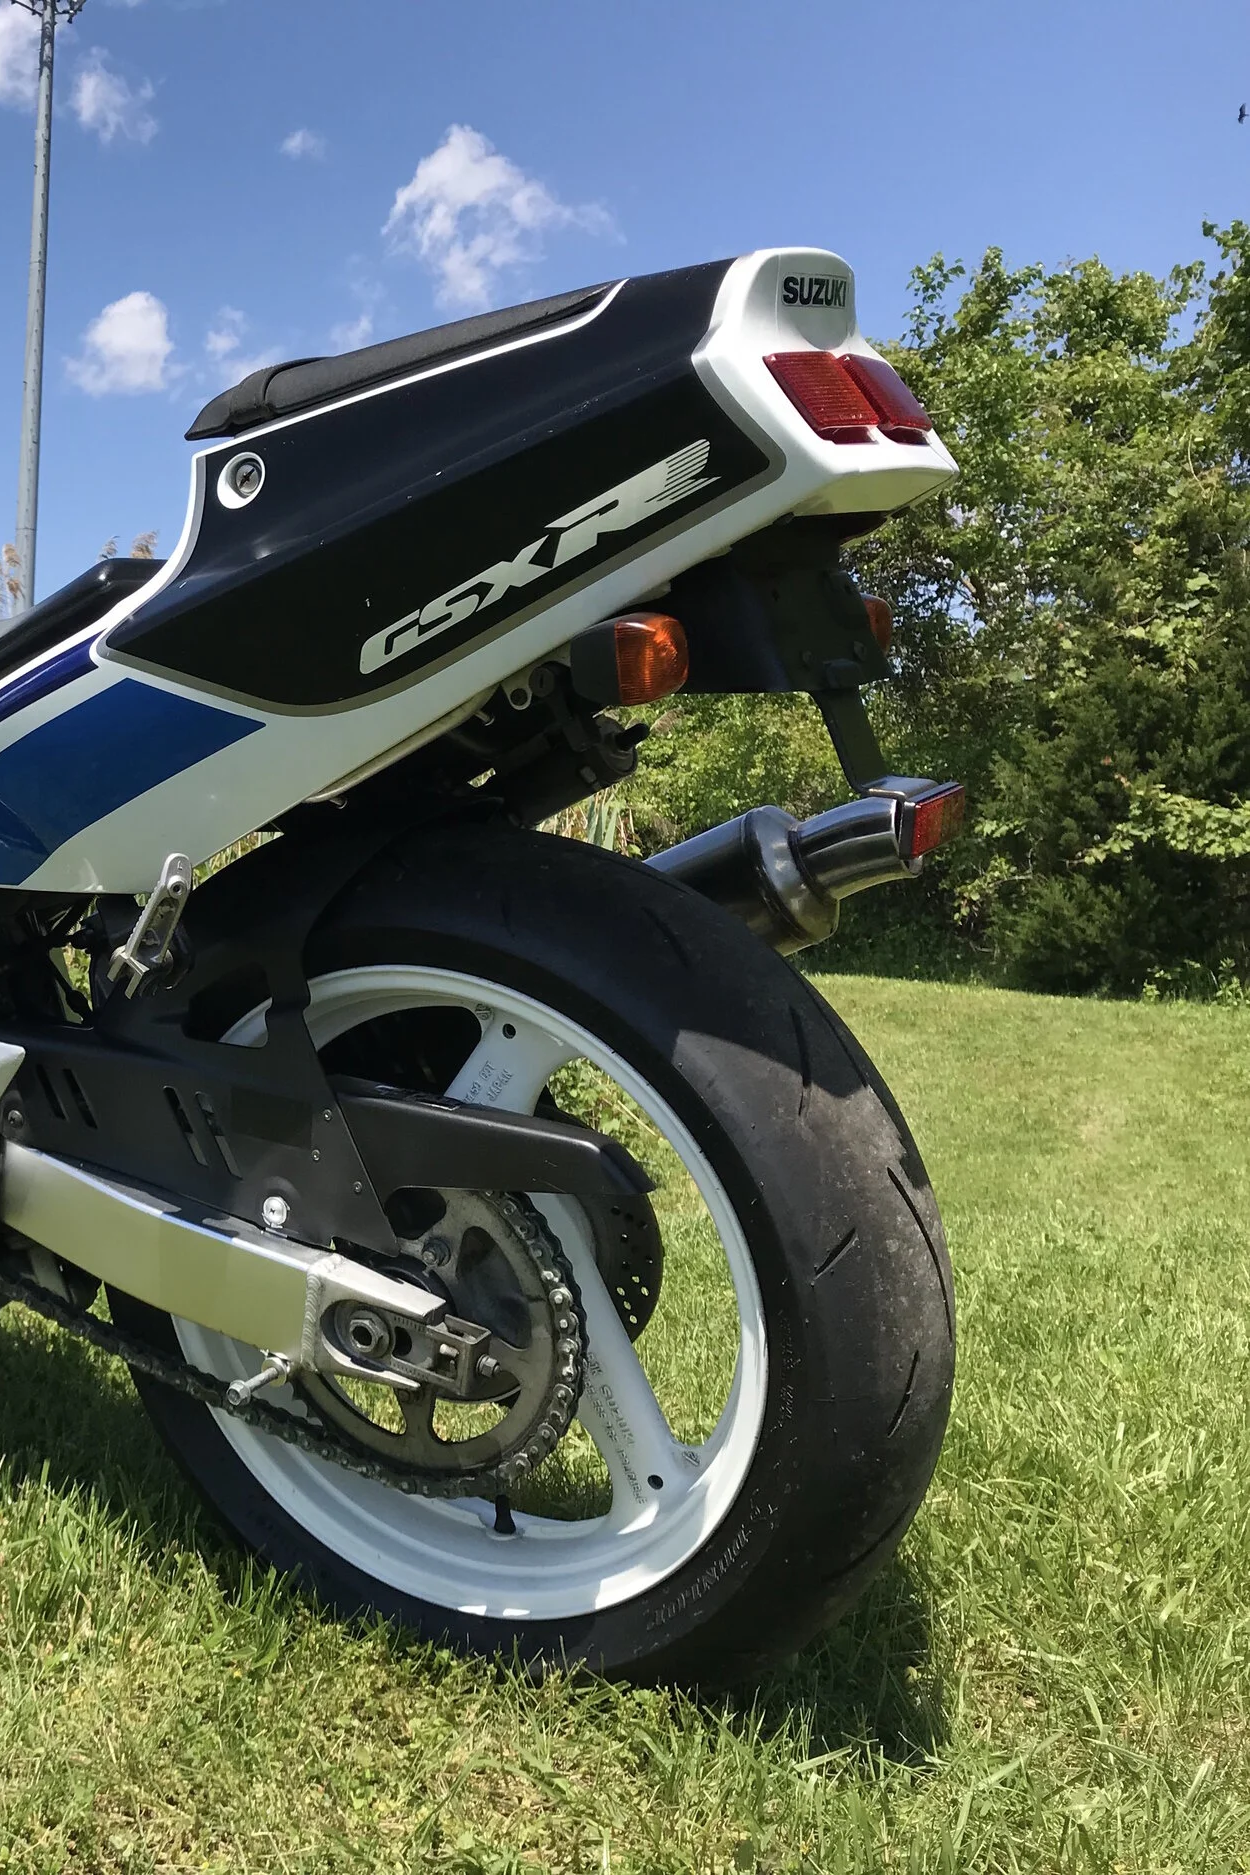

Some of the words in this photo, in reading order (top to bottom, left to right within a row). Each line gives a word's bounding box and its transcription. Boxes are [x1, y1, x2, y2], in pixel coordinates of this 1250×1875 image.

[783, 276, 847, 307] SUZUKI
[487, 1068, 514, 1102] JAPAN
[600, 1384, 635, 1446] SUZUKI
